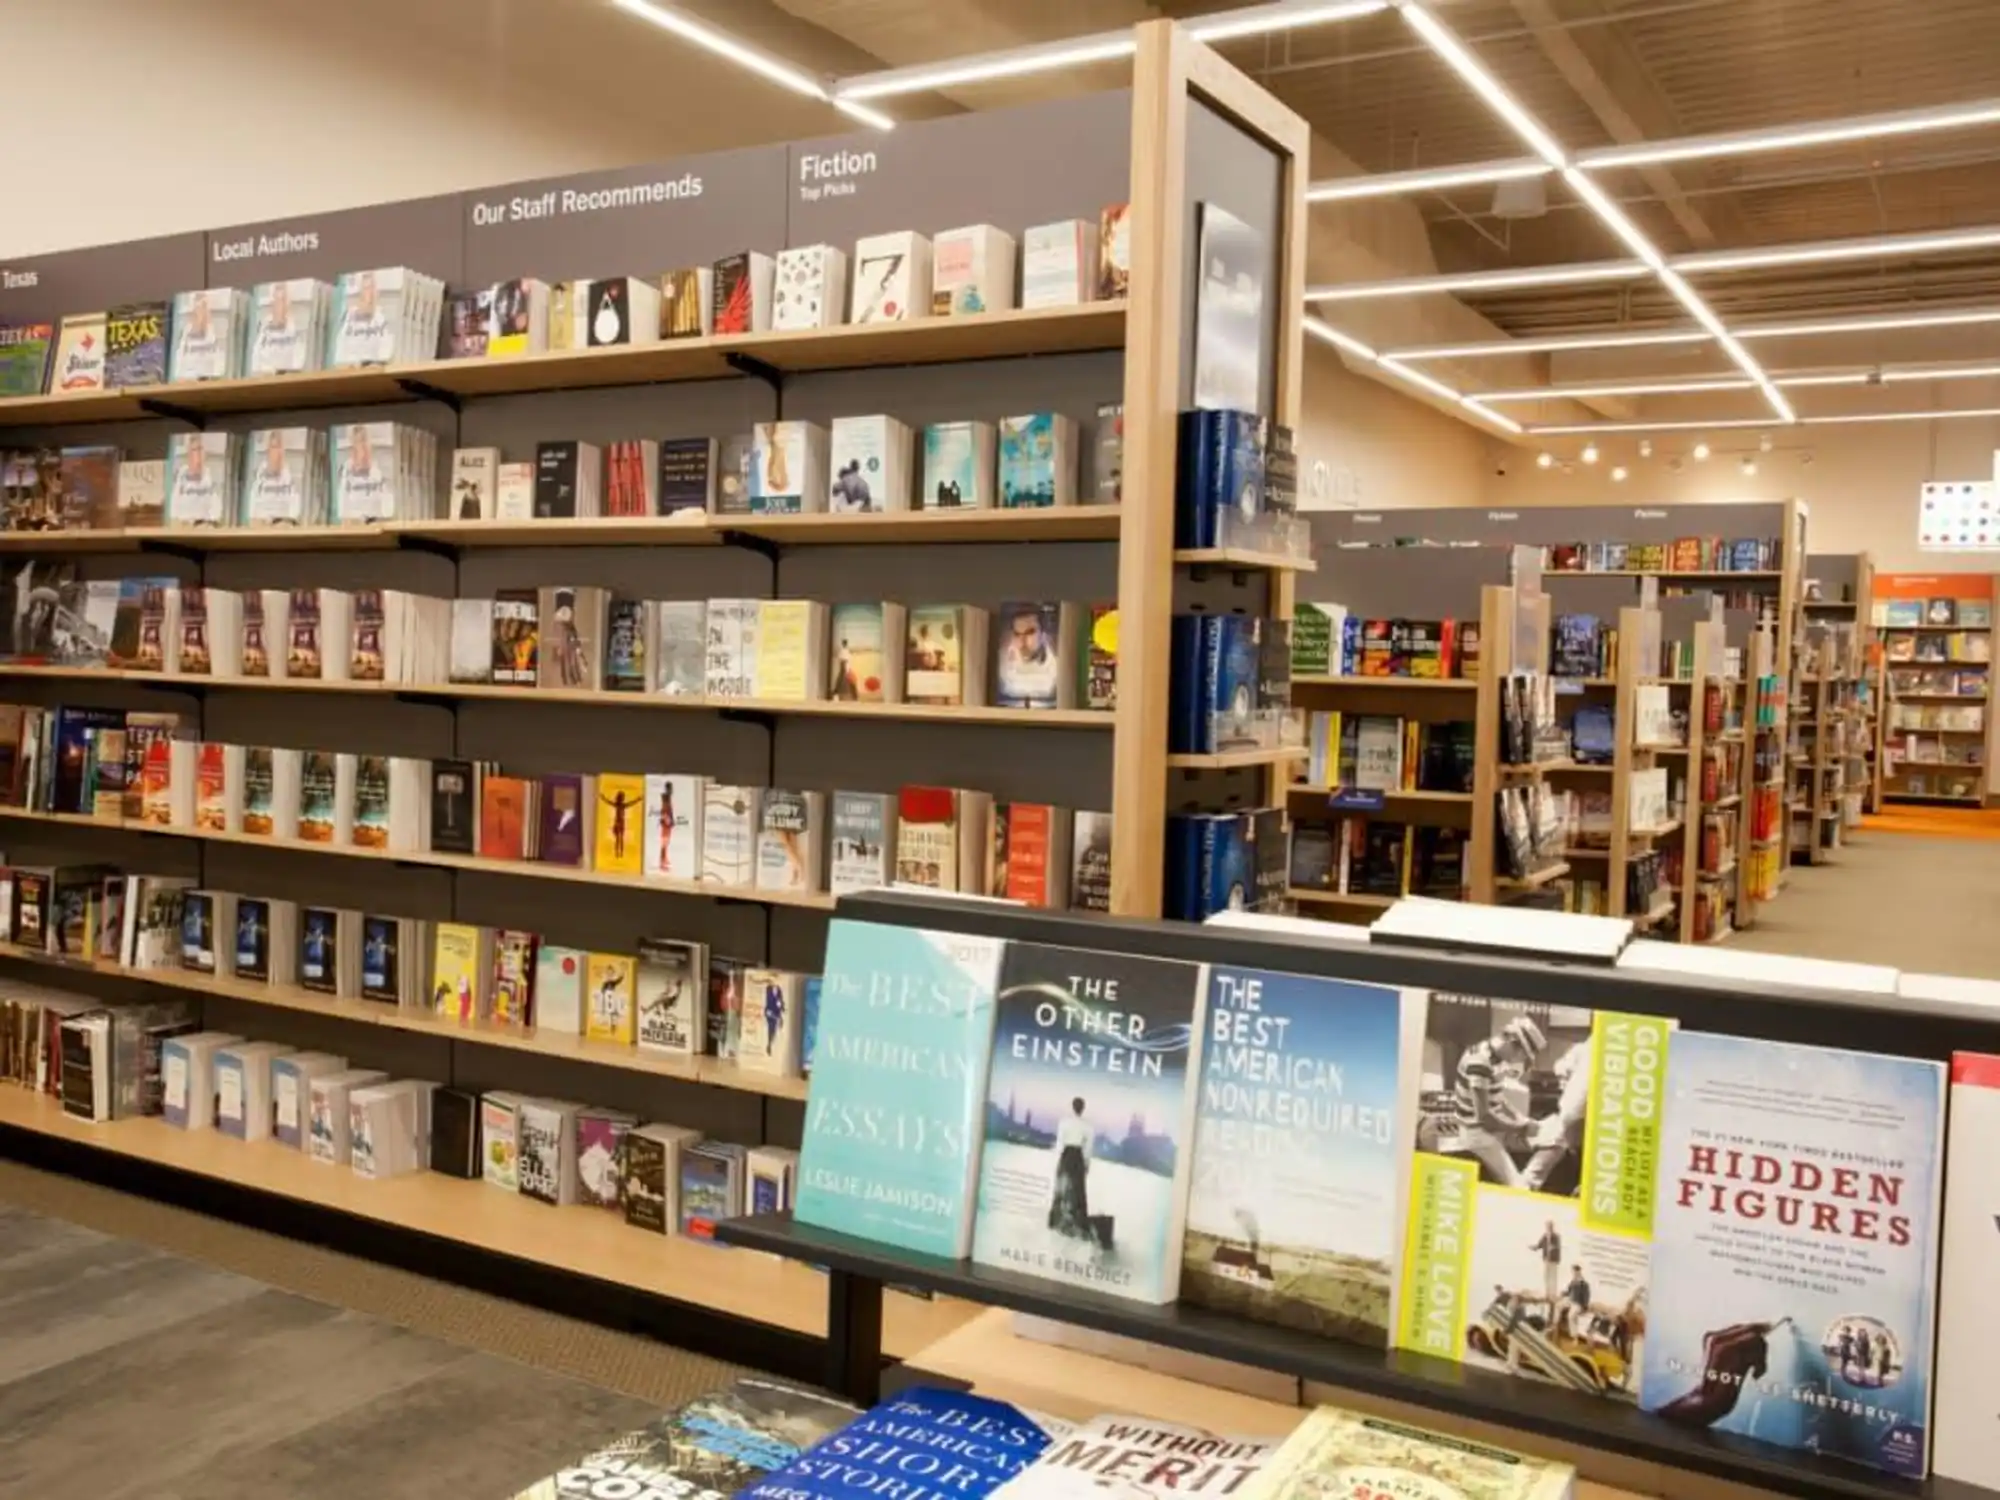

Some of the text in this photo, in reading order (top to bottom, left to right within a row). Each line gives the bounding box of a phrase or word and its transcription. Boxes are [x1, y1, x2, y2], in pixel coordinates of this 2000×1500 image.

[800, 150, 877, 181] Fiction
[473, 172, 703, 226] Our Staff Recommends
[800, 182, 856, 201] Top Picks
[213, 231, 320, 262] Local Authors
[3, 271, 38, 289] Texas
[109, 316, 158, 343] TEXAS
[869, 970, 978, 1021] BEST
[1068, 976, 1120, 1001] THE
[1217, 975, 1263, 1012] THE
[1034, 1003, 1146, 1040] OTHER
[1213, 1008, 1292, 1050] BEST
[827, 1035, 969, 1080] AMERICAN
[1011, 1033, 1164, 1078] EINSTEIN
[1208, 1044, 1344, 1096] AMERICAN
[1630, 1025, 1660, 1119] GOOD
[812, 1097, 961, 1157] ESSAYS
[1205, 1080, 1392, 1145] NONREQUIRED
[1592, 1022, 1630, 1216] VIBRATIONS
[804, 1168, 860, 1196] LESLIE
[864, 1182, 953, 1217] JAMISON
[1688, 1144, 1905, 1207] HIDDEN
[1677, 1178, 1911, 1247] FIGURES
[1000, 1247, 1133, 1287] MARIE BENEDICT
[1426, 1168, 1464, 1351] MIKE LOVE
[936, 1408, 1049, 1447] BES
[1791, 1386, 1900, 1425] SHETTERLY
[821, 1436, 1003, 1491] SHOR
[1104, 1423, 1269, 1461] WITHOUT
[1046, 1440, 1260, 1494] MERIT
